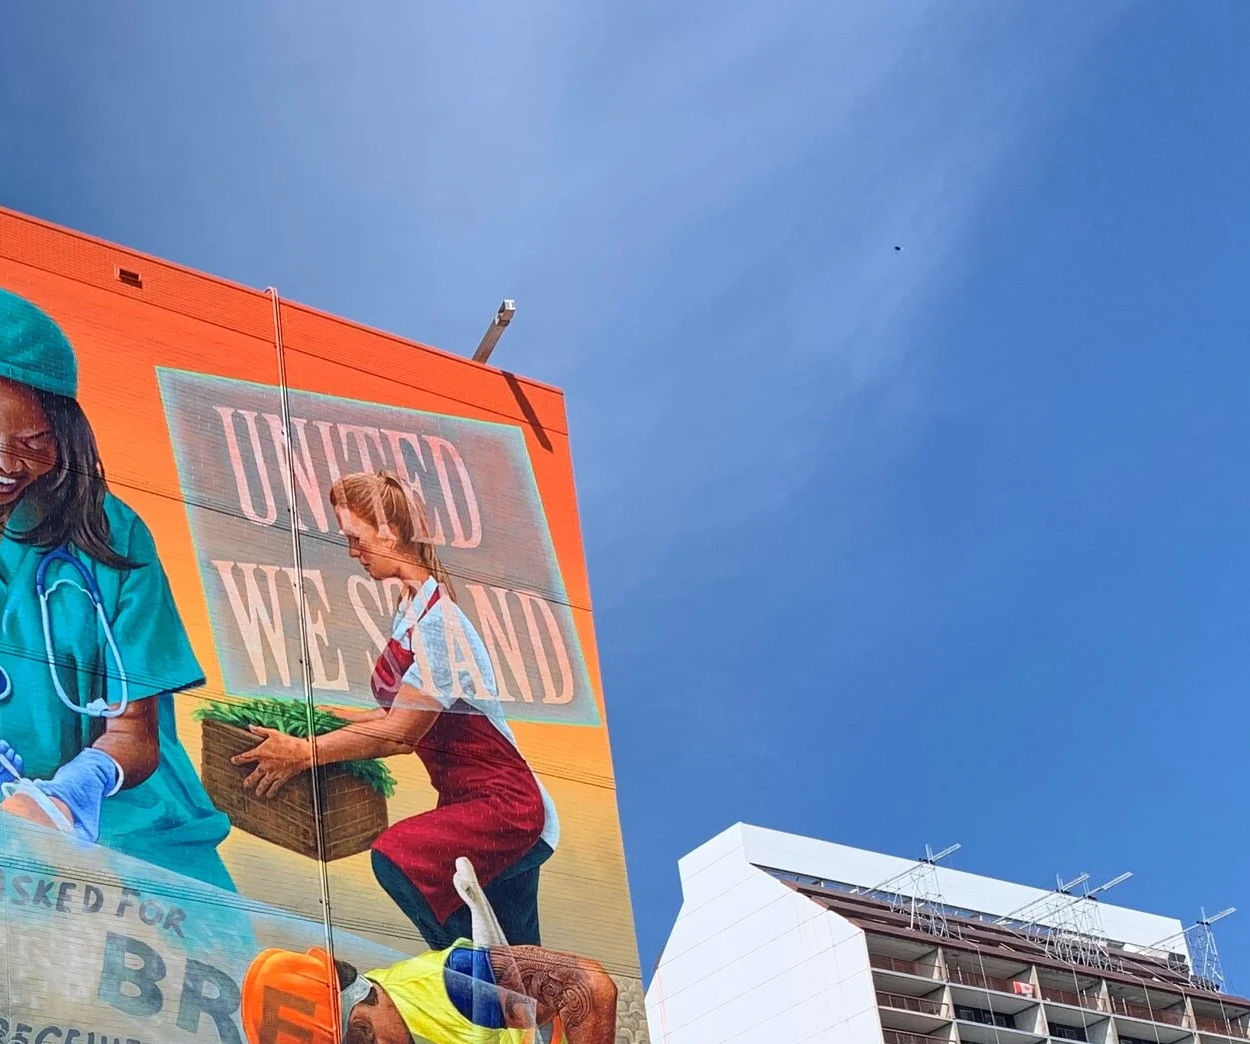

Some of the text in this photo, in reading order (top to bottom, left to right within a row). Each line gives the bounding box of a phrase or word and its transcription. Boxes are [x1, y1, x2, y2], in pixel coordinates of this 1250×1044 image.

[213, 405, 483, 549] UNITED
[212, 559, 349, 692] WE
[347, 574, 575, 705] STAND
[116, 883, 187, 938] FOR
